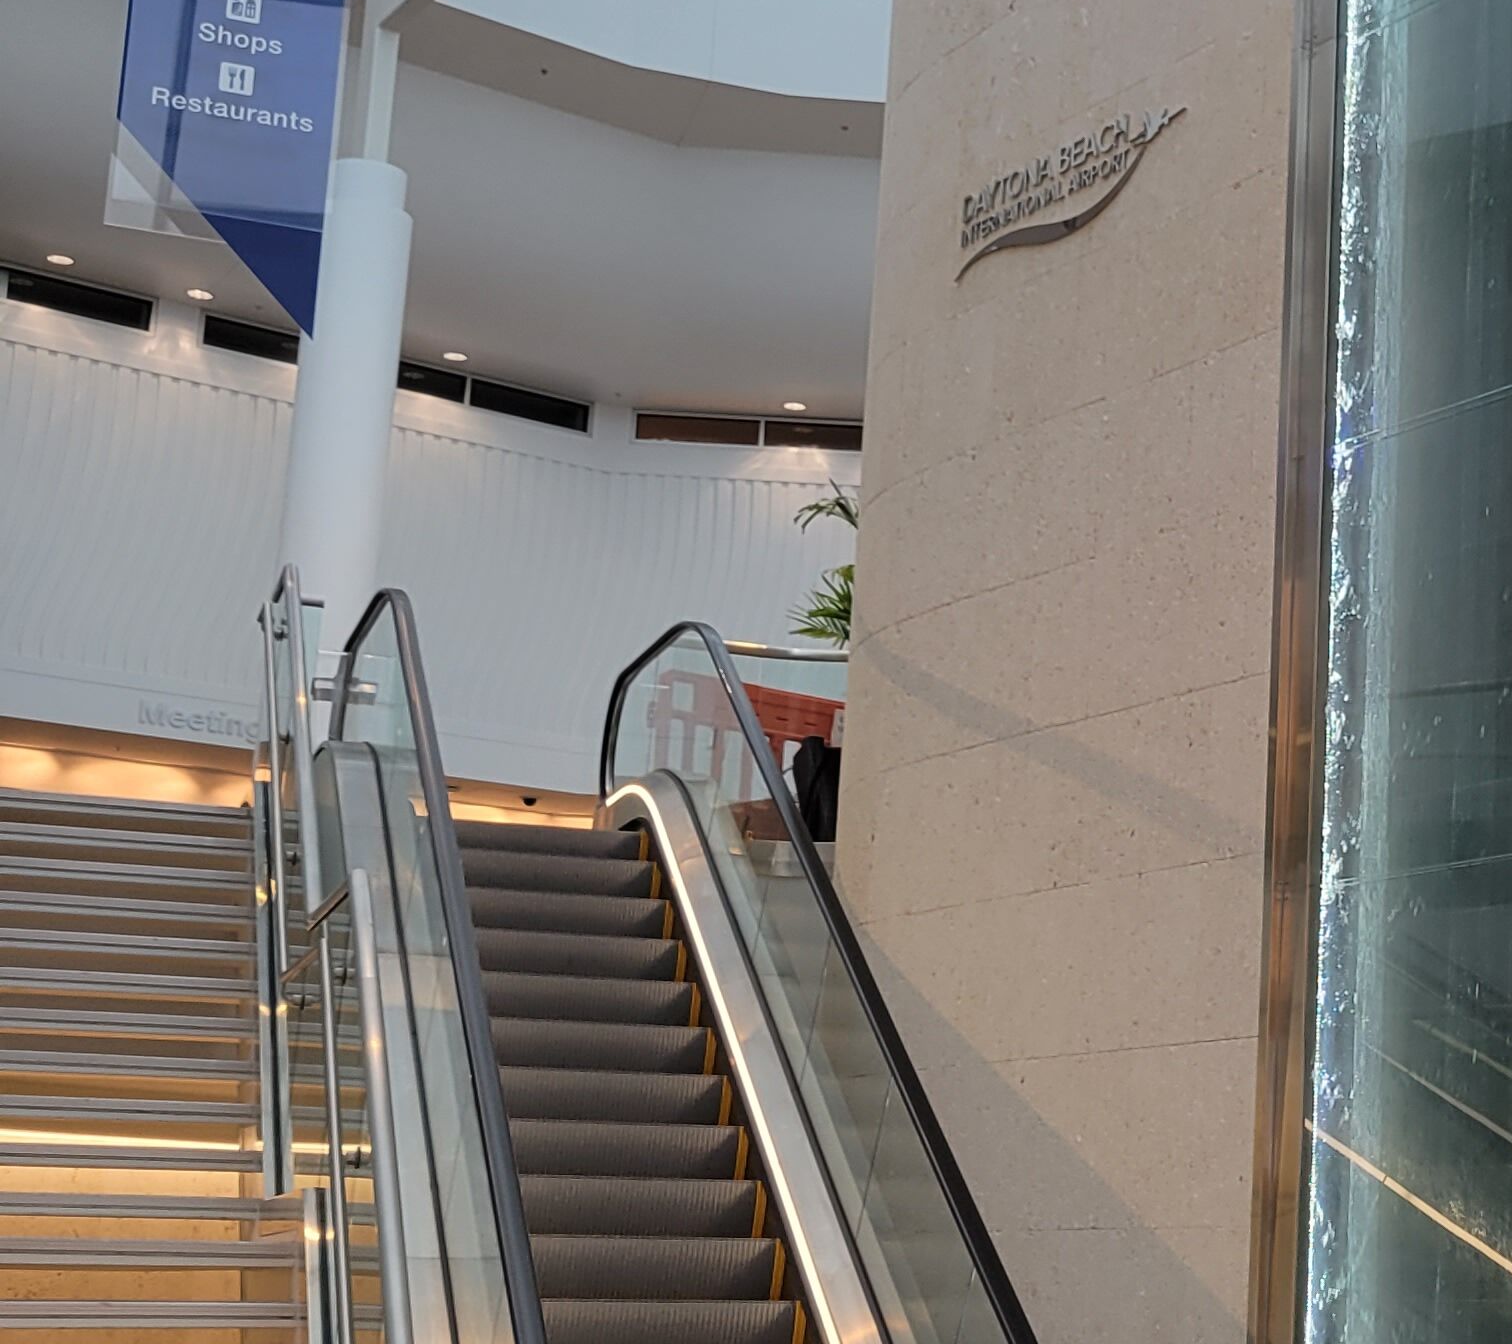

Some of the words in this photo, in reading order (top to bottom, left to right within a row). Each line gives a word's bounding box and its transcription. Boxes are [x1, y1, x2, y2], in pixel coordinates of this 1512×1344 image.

[198, 22, 284, 56] Shops
[151, 85, 314, 133] Restaurants
[962, 156, 1054, 225] DAYTONA
[1059, 112, 1131, 174] BEACH
[960, 180, 1066, 249] INTERNATIONAL
[1067, 148, 1130, 197] AIRPORT
[137, 699, 262, 746] Meeting
